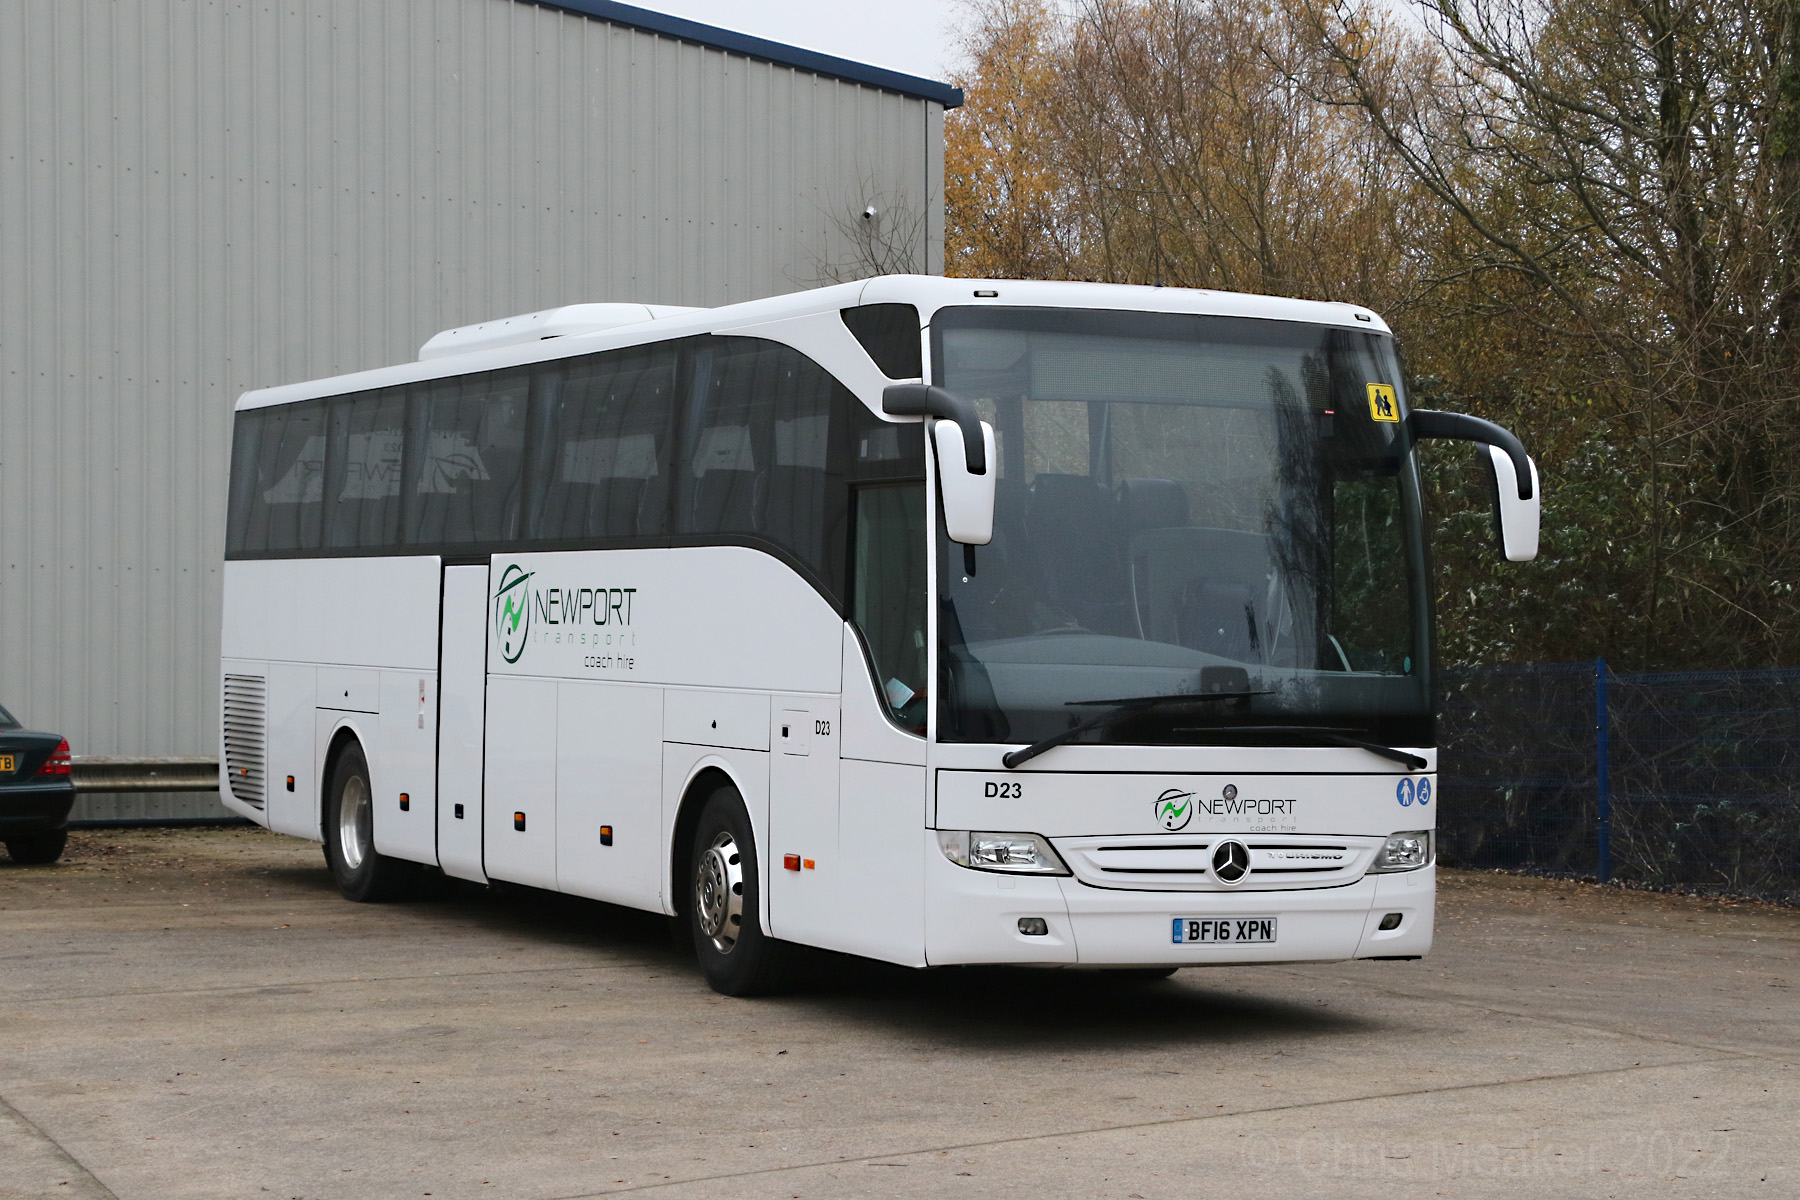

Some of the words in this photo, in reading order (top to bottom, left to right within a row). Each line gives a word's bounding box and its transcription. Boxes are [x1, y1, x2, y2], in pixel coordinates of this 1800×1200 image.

[535, 588, 637, 626] NEWPORT
[534, 630, 636, 649] transport
[584, 652, 613, 669] coach
[617, 652, 635, 669] hire
[815, 720, 831, 736] D23
[984, 782, 1022, 799] D23
[1198, 799, 1297, 815] NEWPORT
[1198, 816, 1297, 824] transport
[1249, 824, 1277, 832] coach
[1280, 824, 1297, 832] hire
[1188, 921, 1230, 941] BF16
[1235, 920, 1272, 940] XPN
